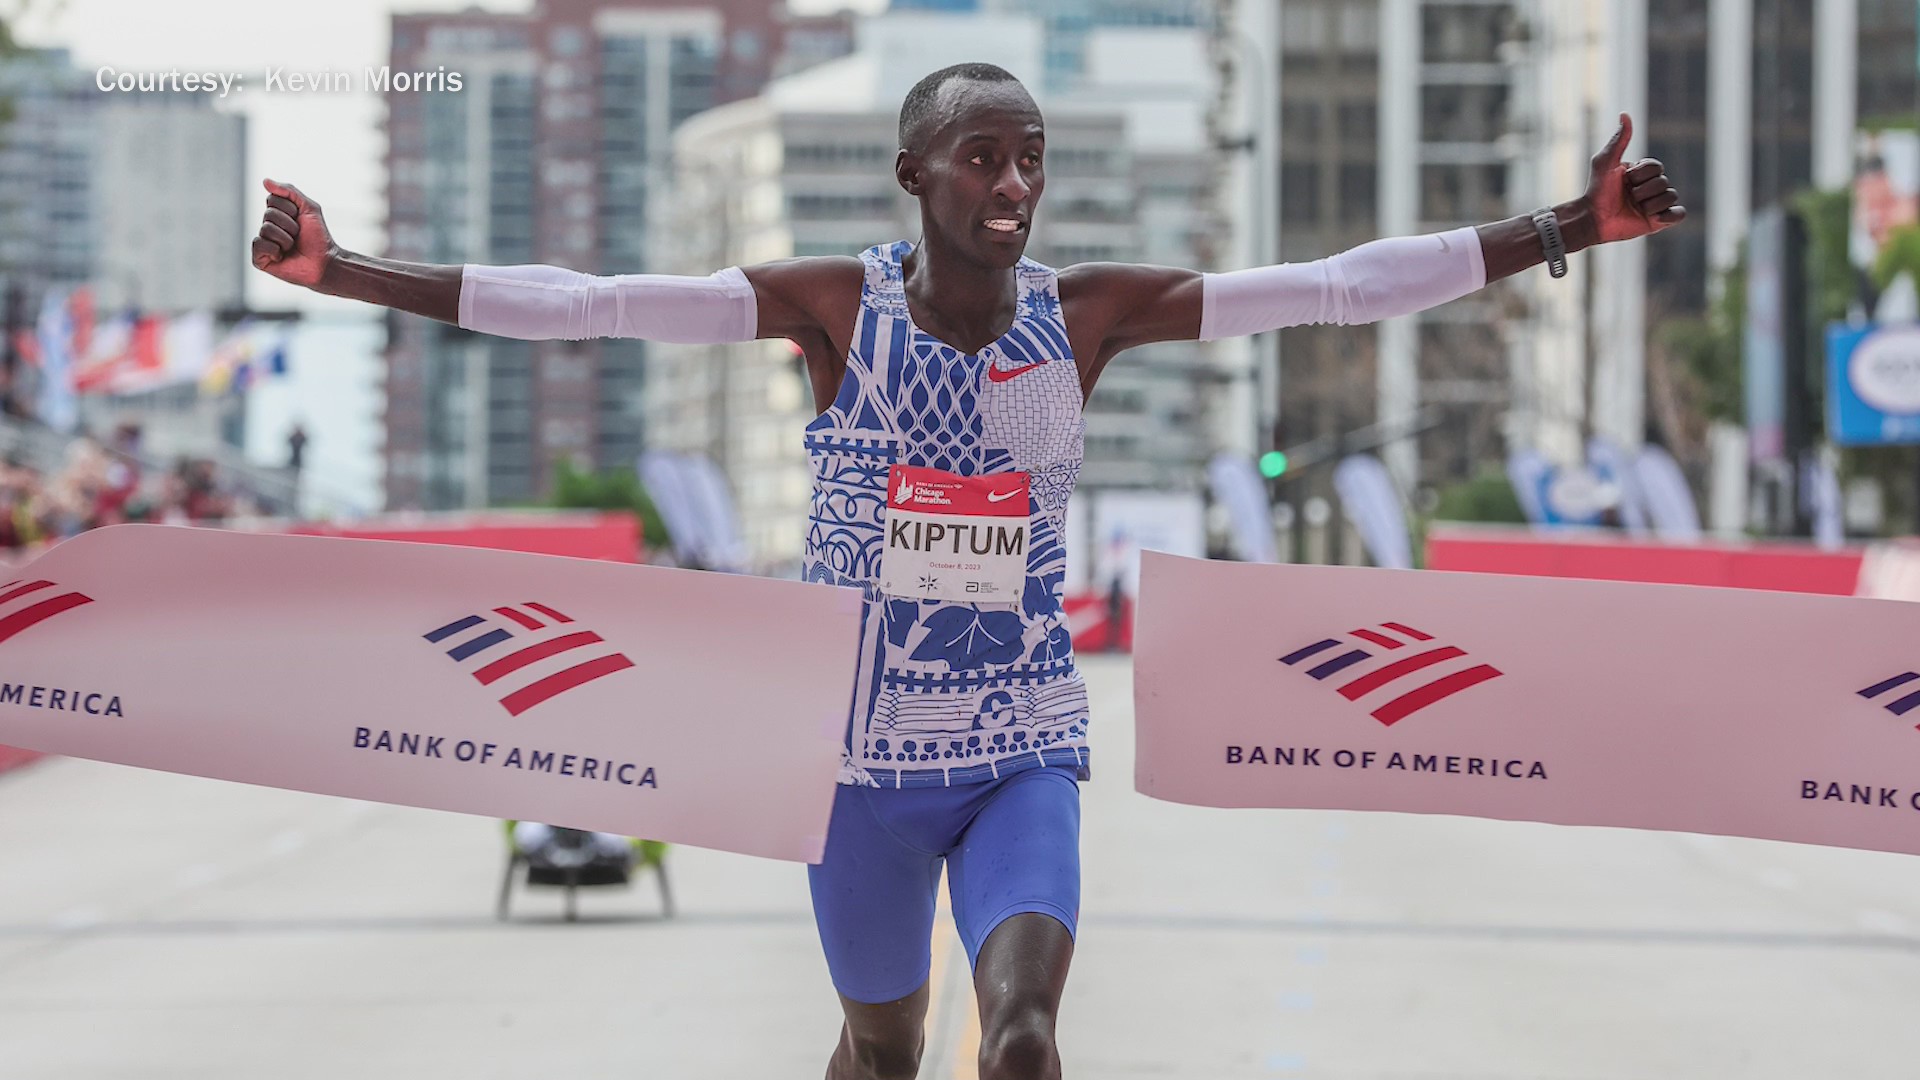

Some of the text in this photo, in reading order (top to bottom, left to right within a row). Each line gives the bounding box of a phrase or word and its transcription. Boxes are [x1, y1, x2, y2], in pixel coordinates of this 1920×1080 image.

[915, 487, 945, 499] Chicago
[890, 519, 1024, 556] KIPTUM
[929, 561, 955, 569] October
[964, 563, 981, 571] 2023
[353, 727, 659, 789] BANK OF AMERICA
[1226, 745, 1548, 780] BANK OF AMERICA
[1801, 780, 1898, 808] BANK
